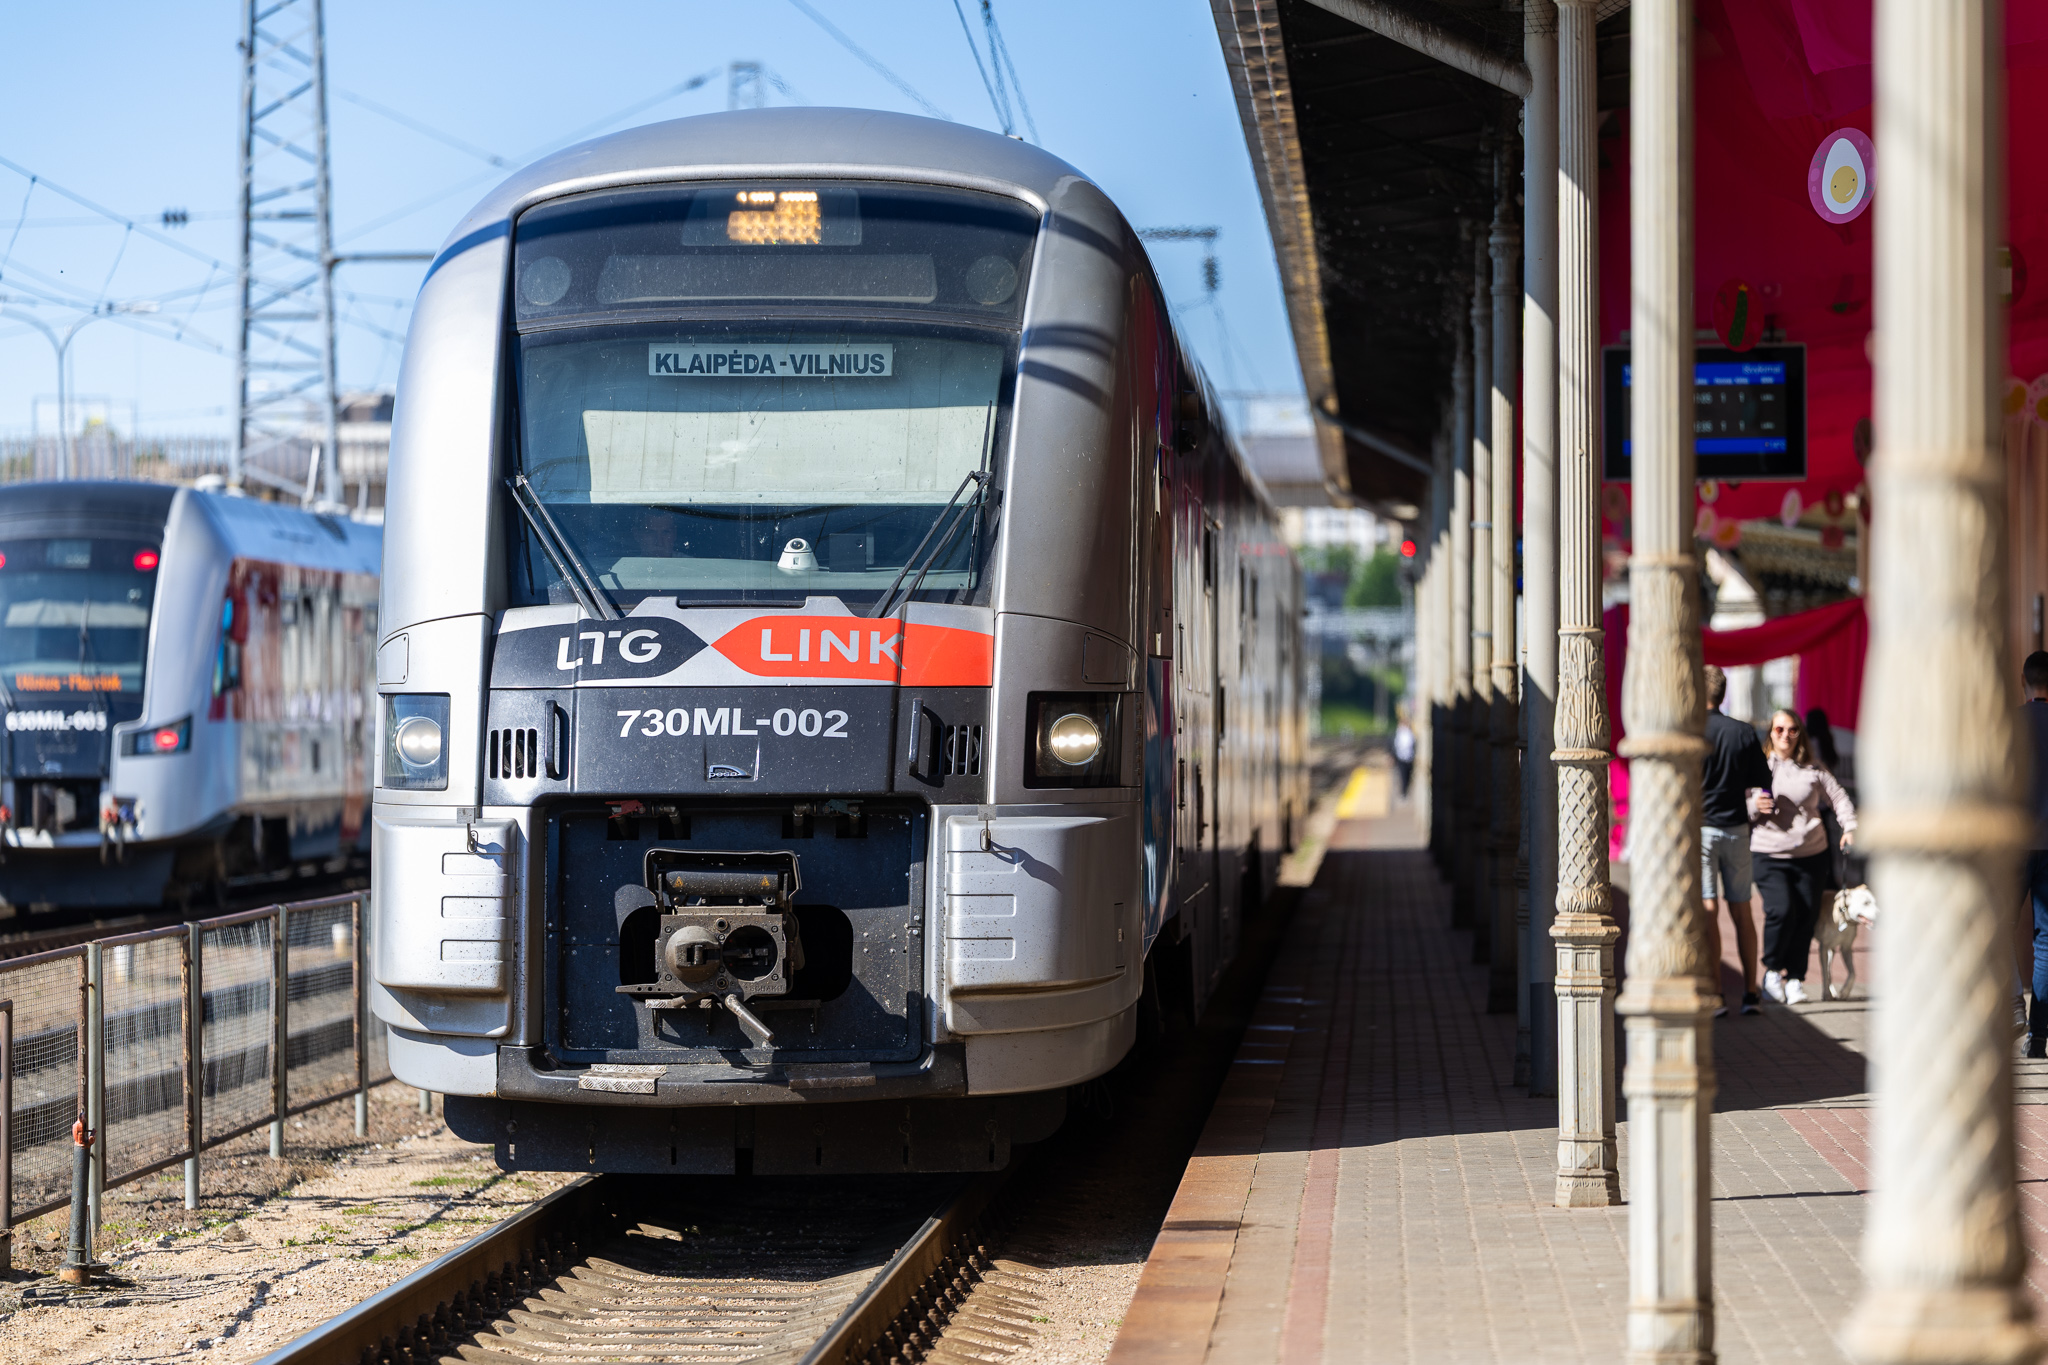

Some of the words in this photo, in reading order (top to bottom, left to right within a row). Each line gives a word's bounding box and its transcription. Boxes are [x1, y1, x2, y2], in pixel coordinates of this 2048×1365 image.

[556, 629, 663, 671] LTG
[760, 628, 908, 670] LINK
[616, 707, 849, 739] 730ML-002
